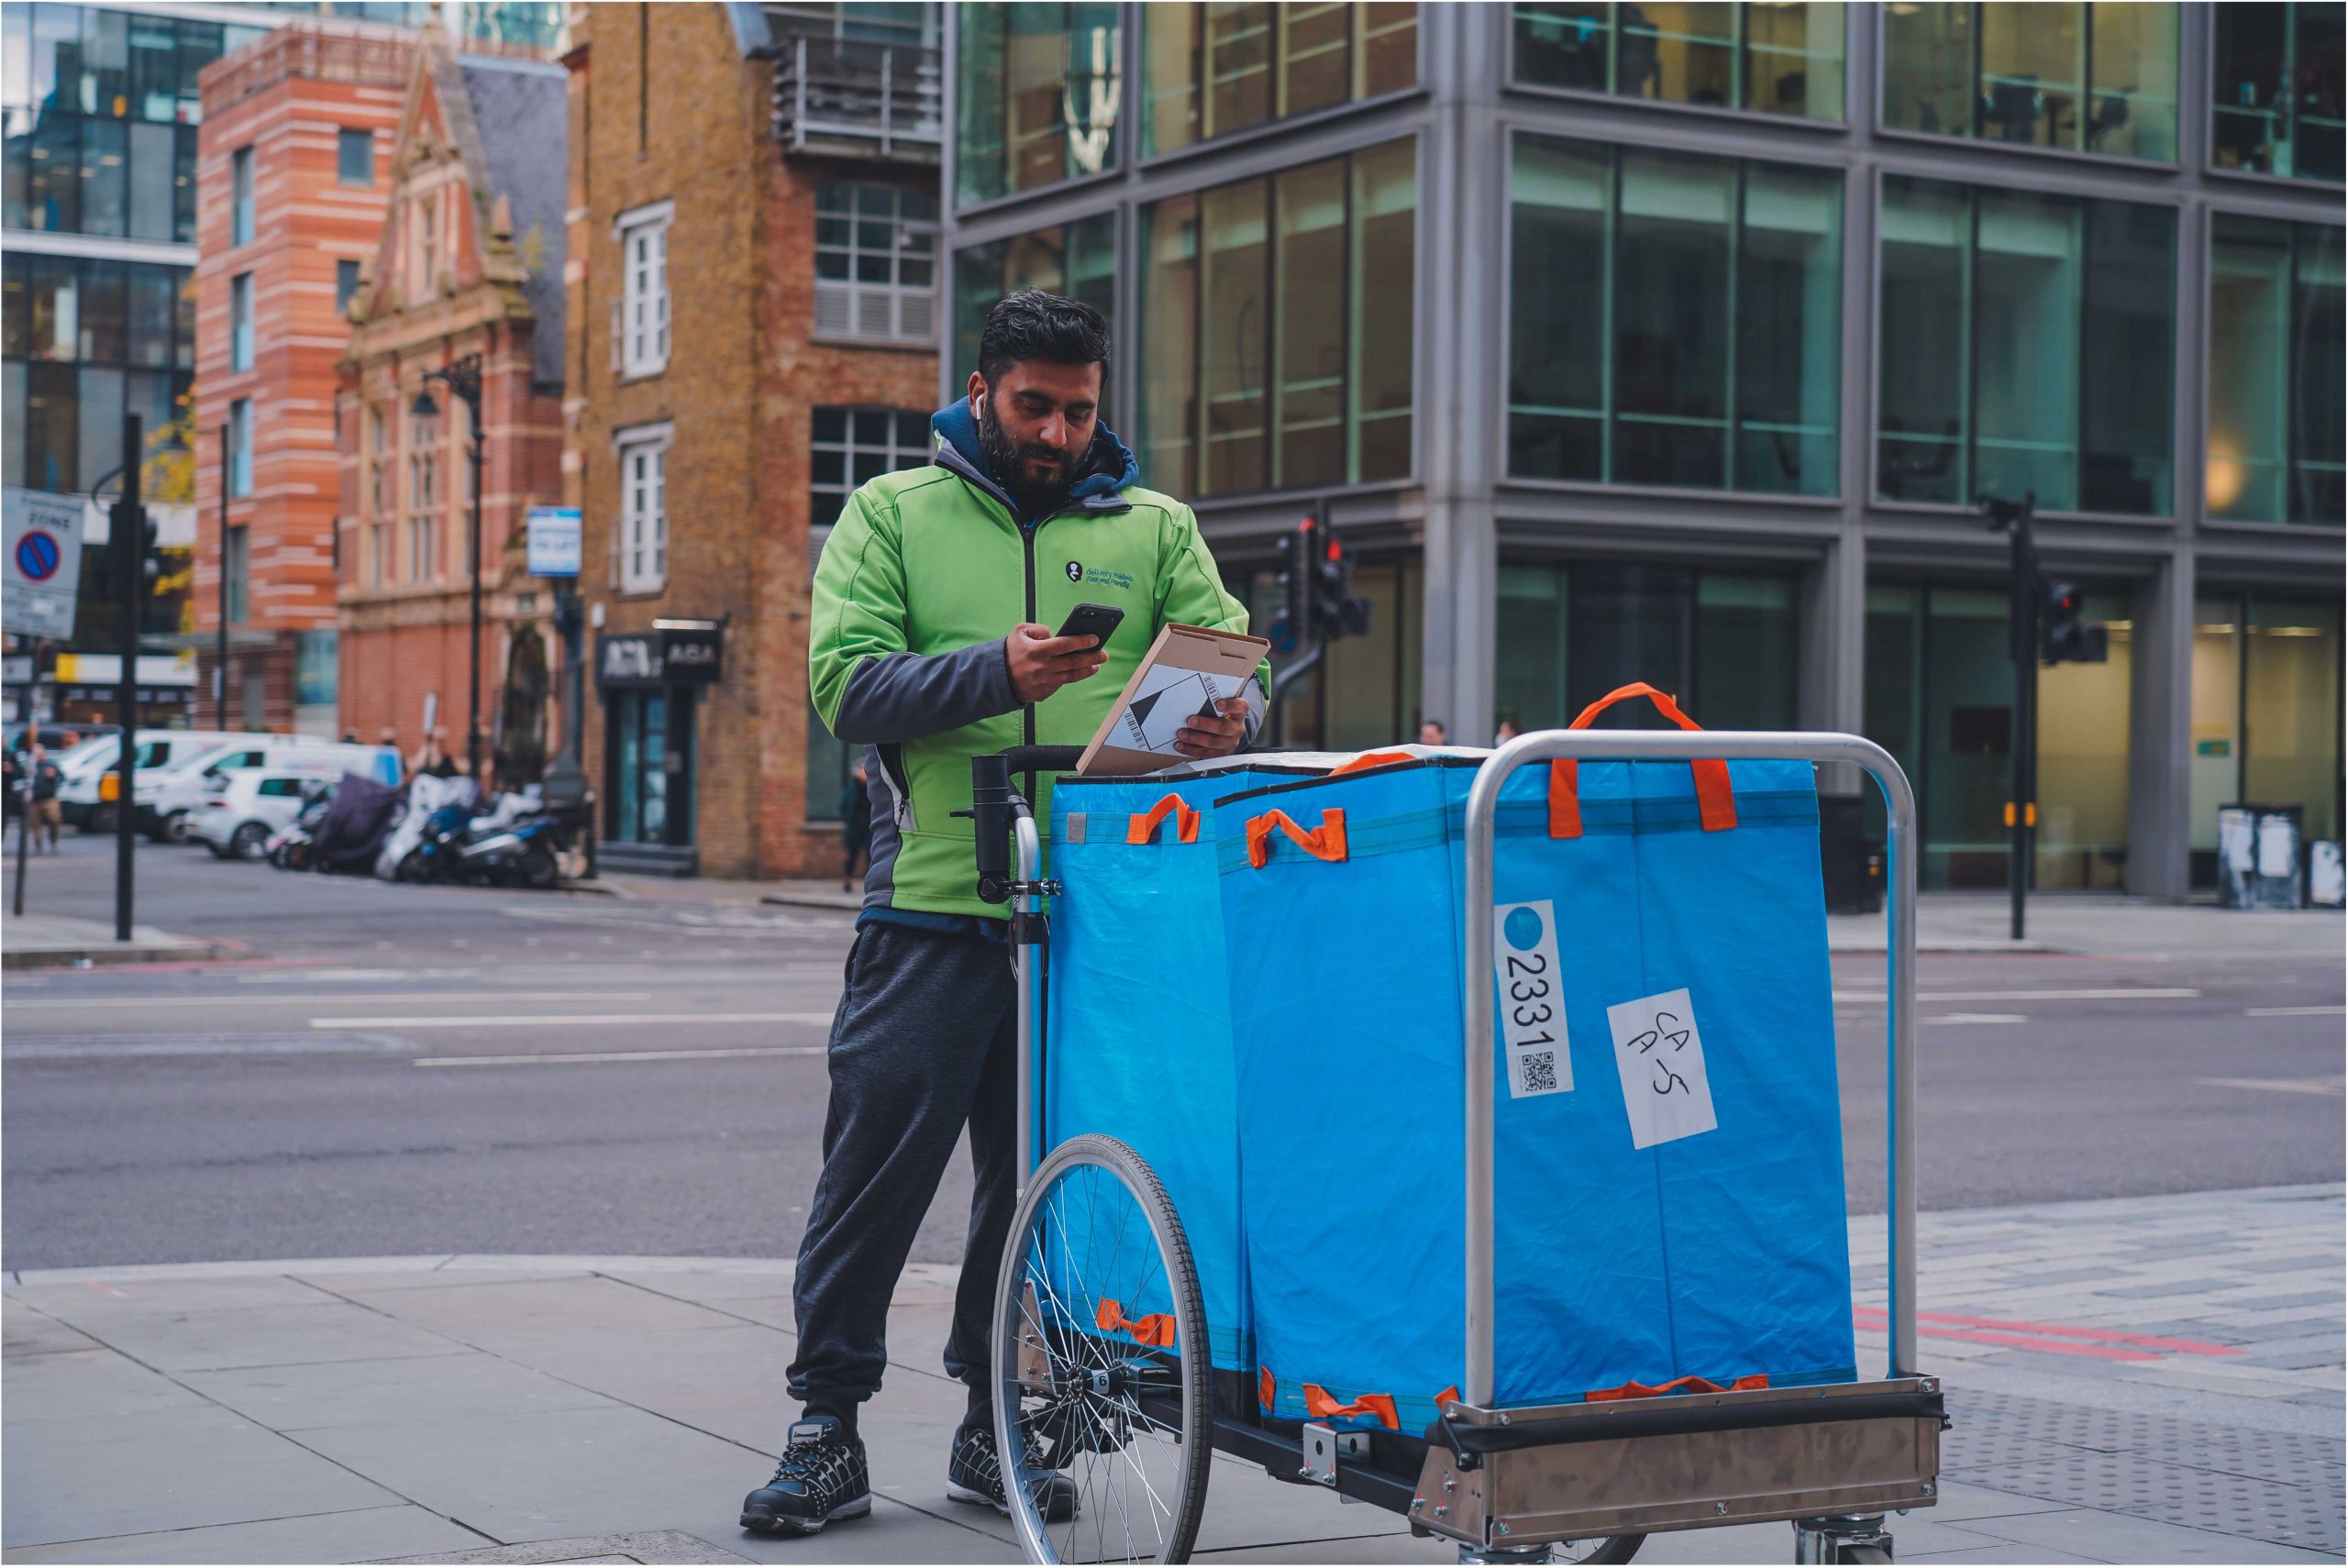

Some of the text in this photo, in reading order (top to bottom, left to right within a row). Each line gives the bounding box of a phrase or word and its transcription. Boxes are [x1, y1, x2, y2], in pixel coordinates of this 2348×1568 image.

[1086, 569, 1112, 579] delivery
[1507, 954, 1556, 1047] 2331
[1099, 1375, 1107, 1386] 6
